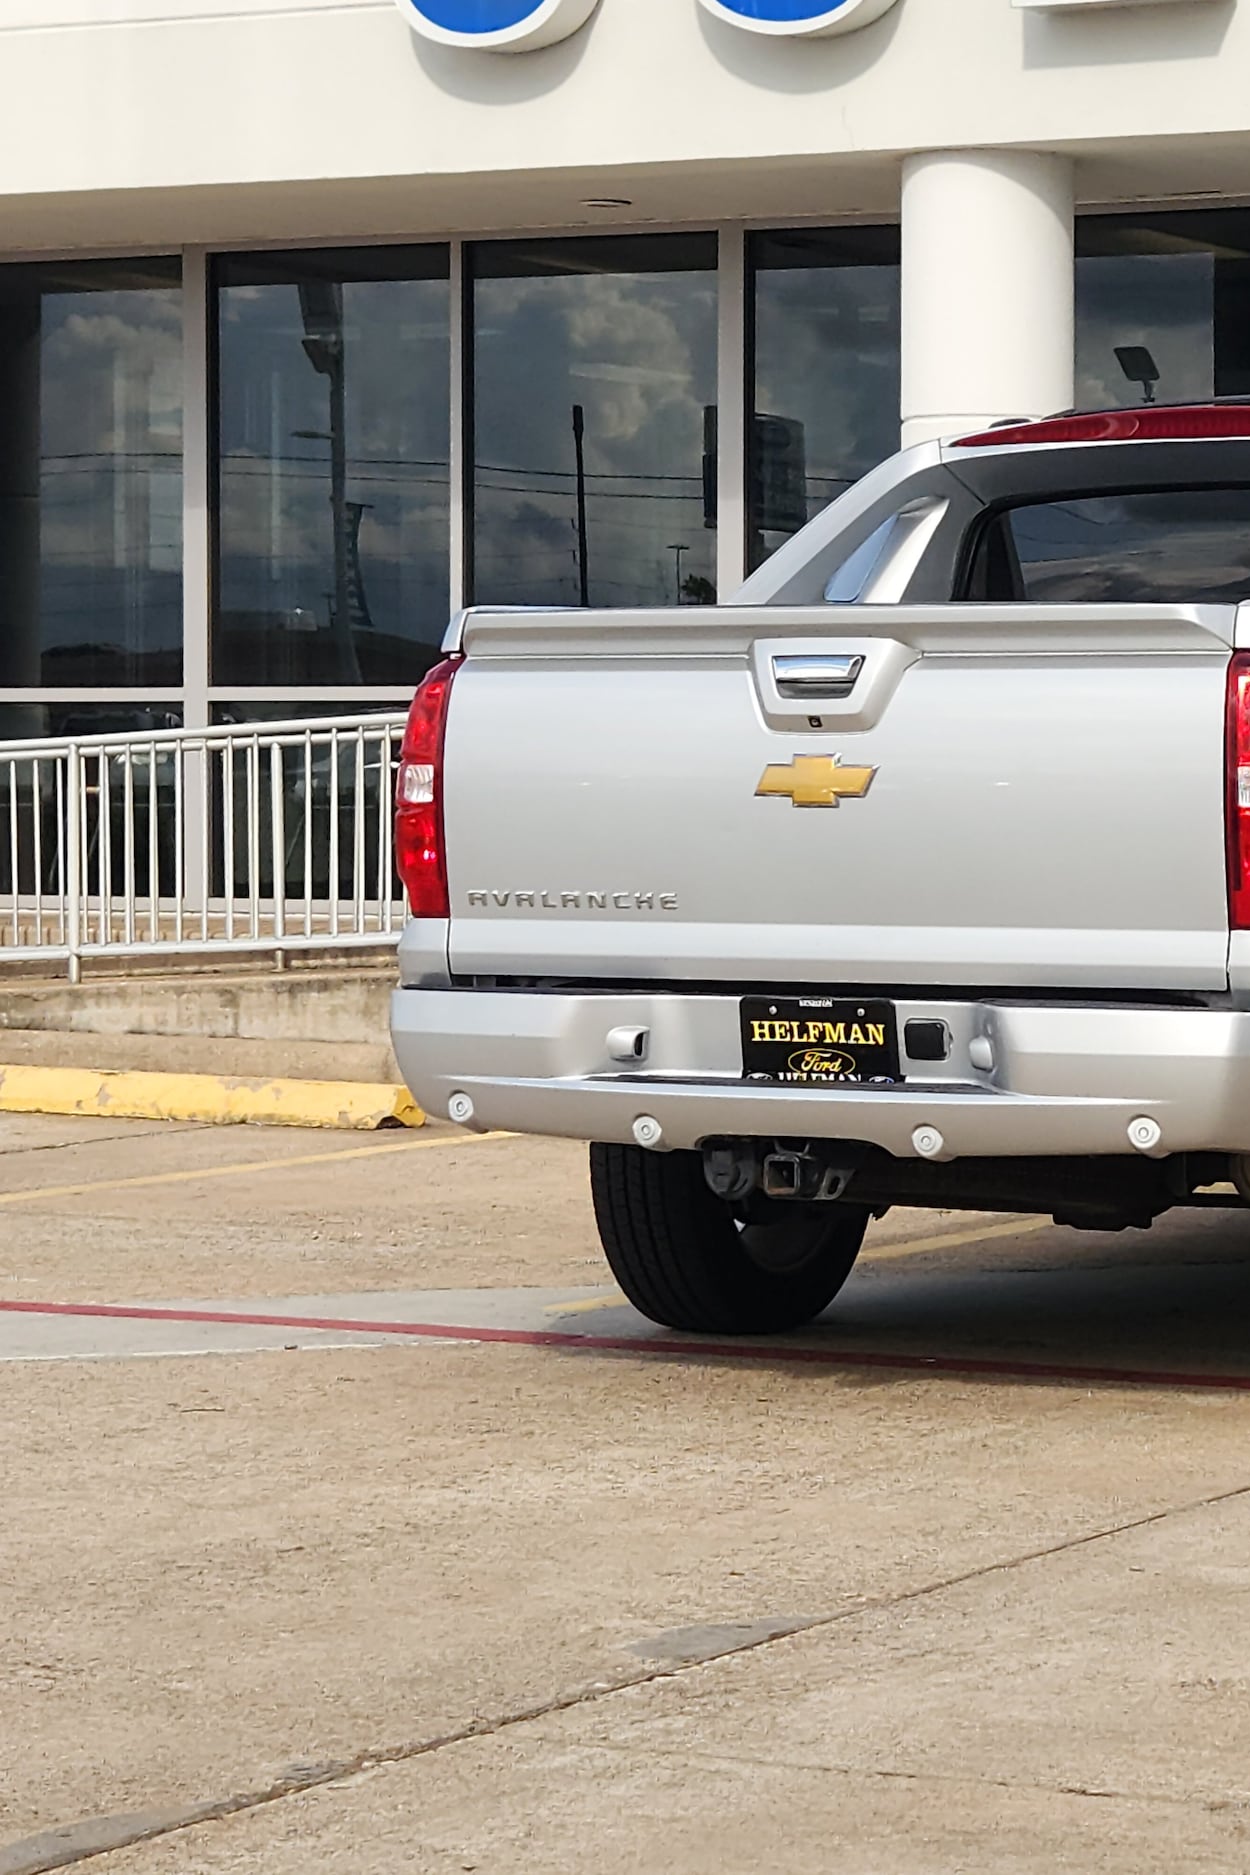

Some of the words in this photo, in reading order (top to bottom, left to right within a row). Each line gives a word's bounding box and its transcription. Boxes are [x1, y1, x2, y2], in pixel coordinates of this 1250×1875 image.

[466, 889, 679, 910] AVALANCHE
[750, 1020, 886, 1046] HELFMAN
[801, 1051, 843, 1073] Ford
